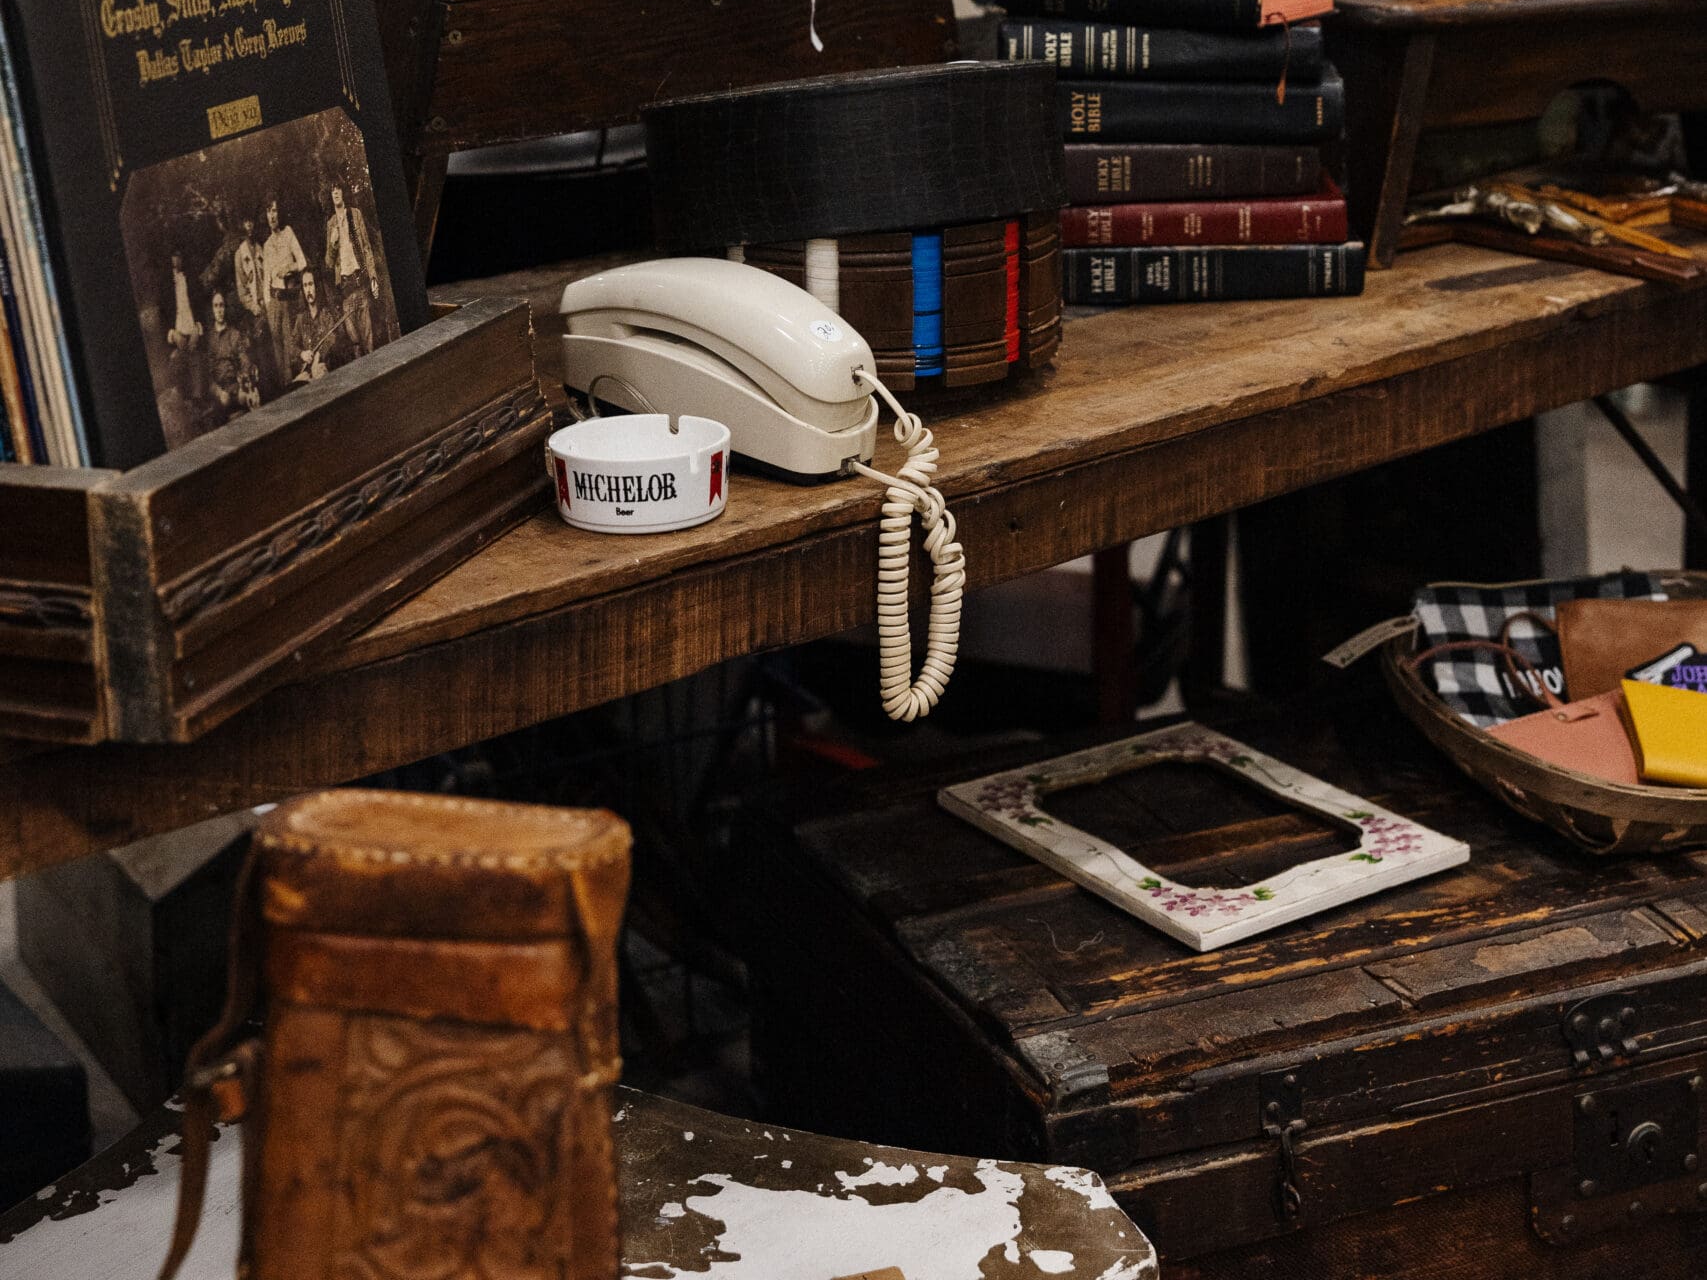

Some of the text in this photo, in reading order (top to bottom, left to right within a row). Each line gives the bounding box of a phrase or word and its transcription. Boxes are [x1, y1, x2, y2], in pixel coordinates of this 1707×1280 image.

[1060, 32, 1072, 67] BIBLE
[1072, 91, 1085, 132] HOLY
[1088, 93, 1101, 132] BIBLE
[1098, 157, 1109, 191] HOLY
[1111, 156, 1122, 191] BIBLE
[1087, 209, 1099, 244] HOLY
[1100, 208, 1112, 244] BIBLE
[1091, 257, 1102, 293] HOLY
[1104, 256, 1116, 292] BIBLE
[573, 471, 677, 502] MICHELOB
[615, 507, 635, 516] Beer
